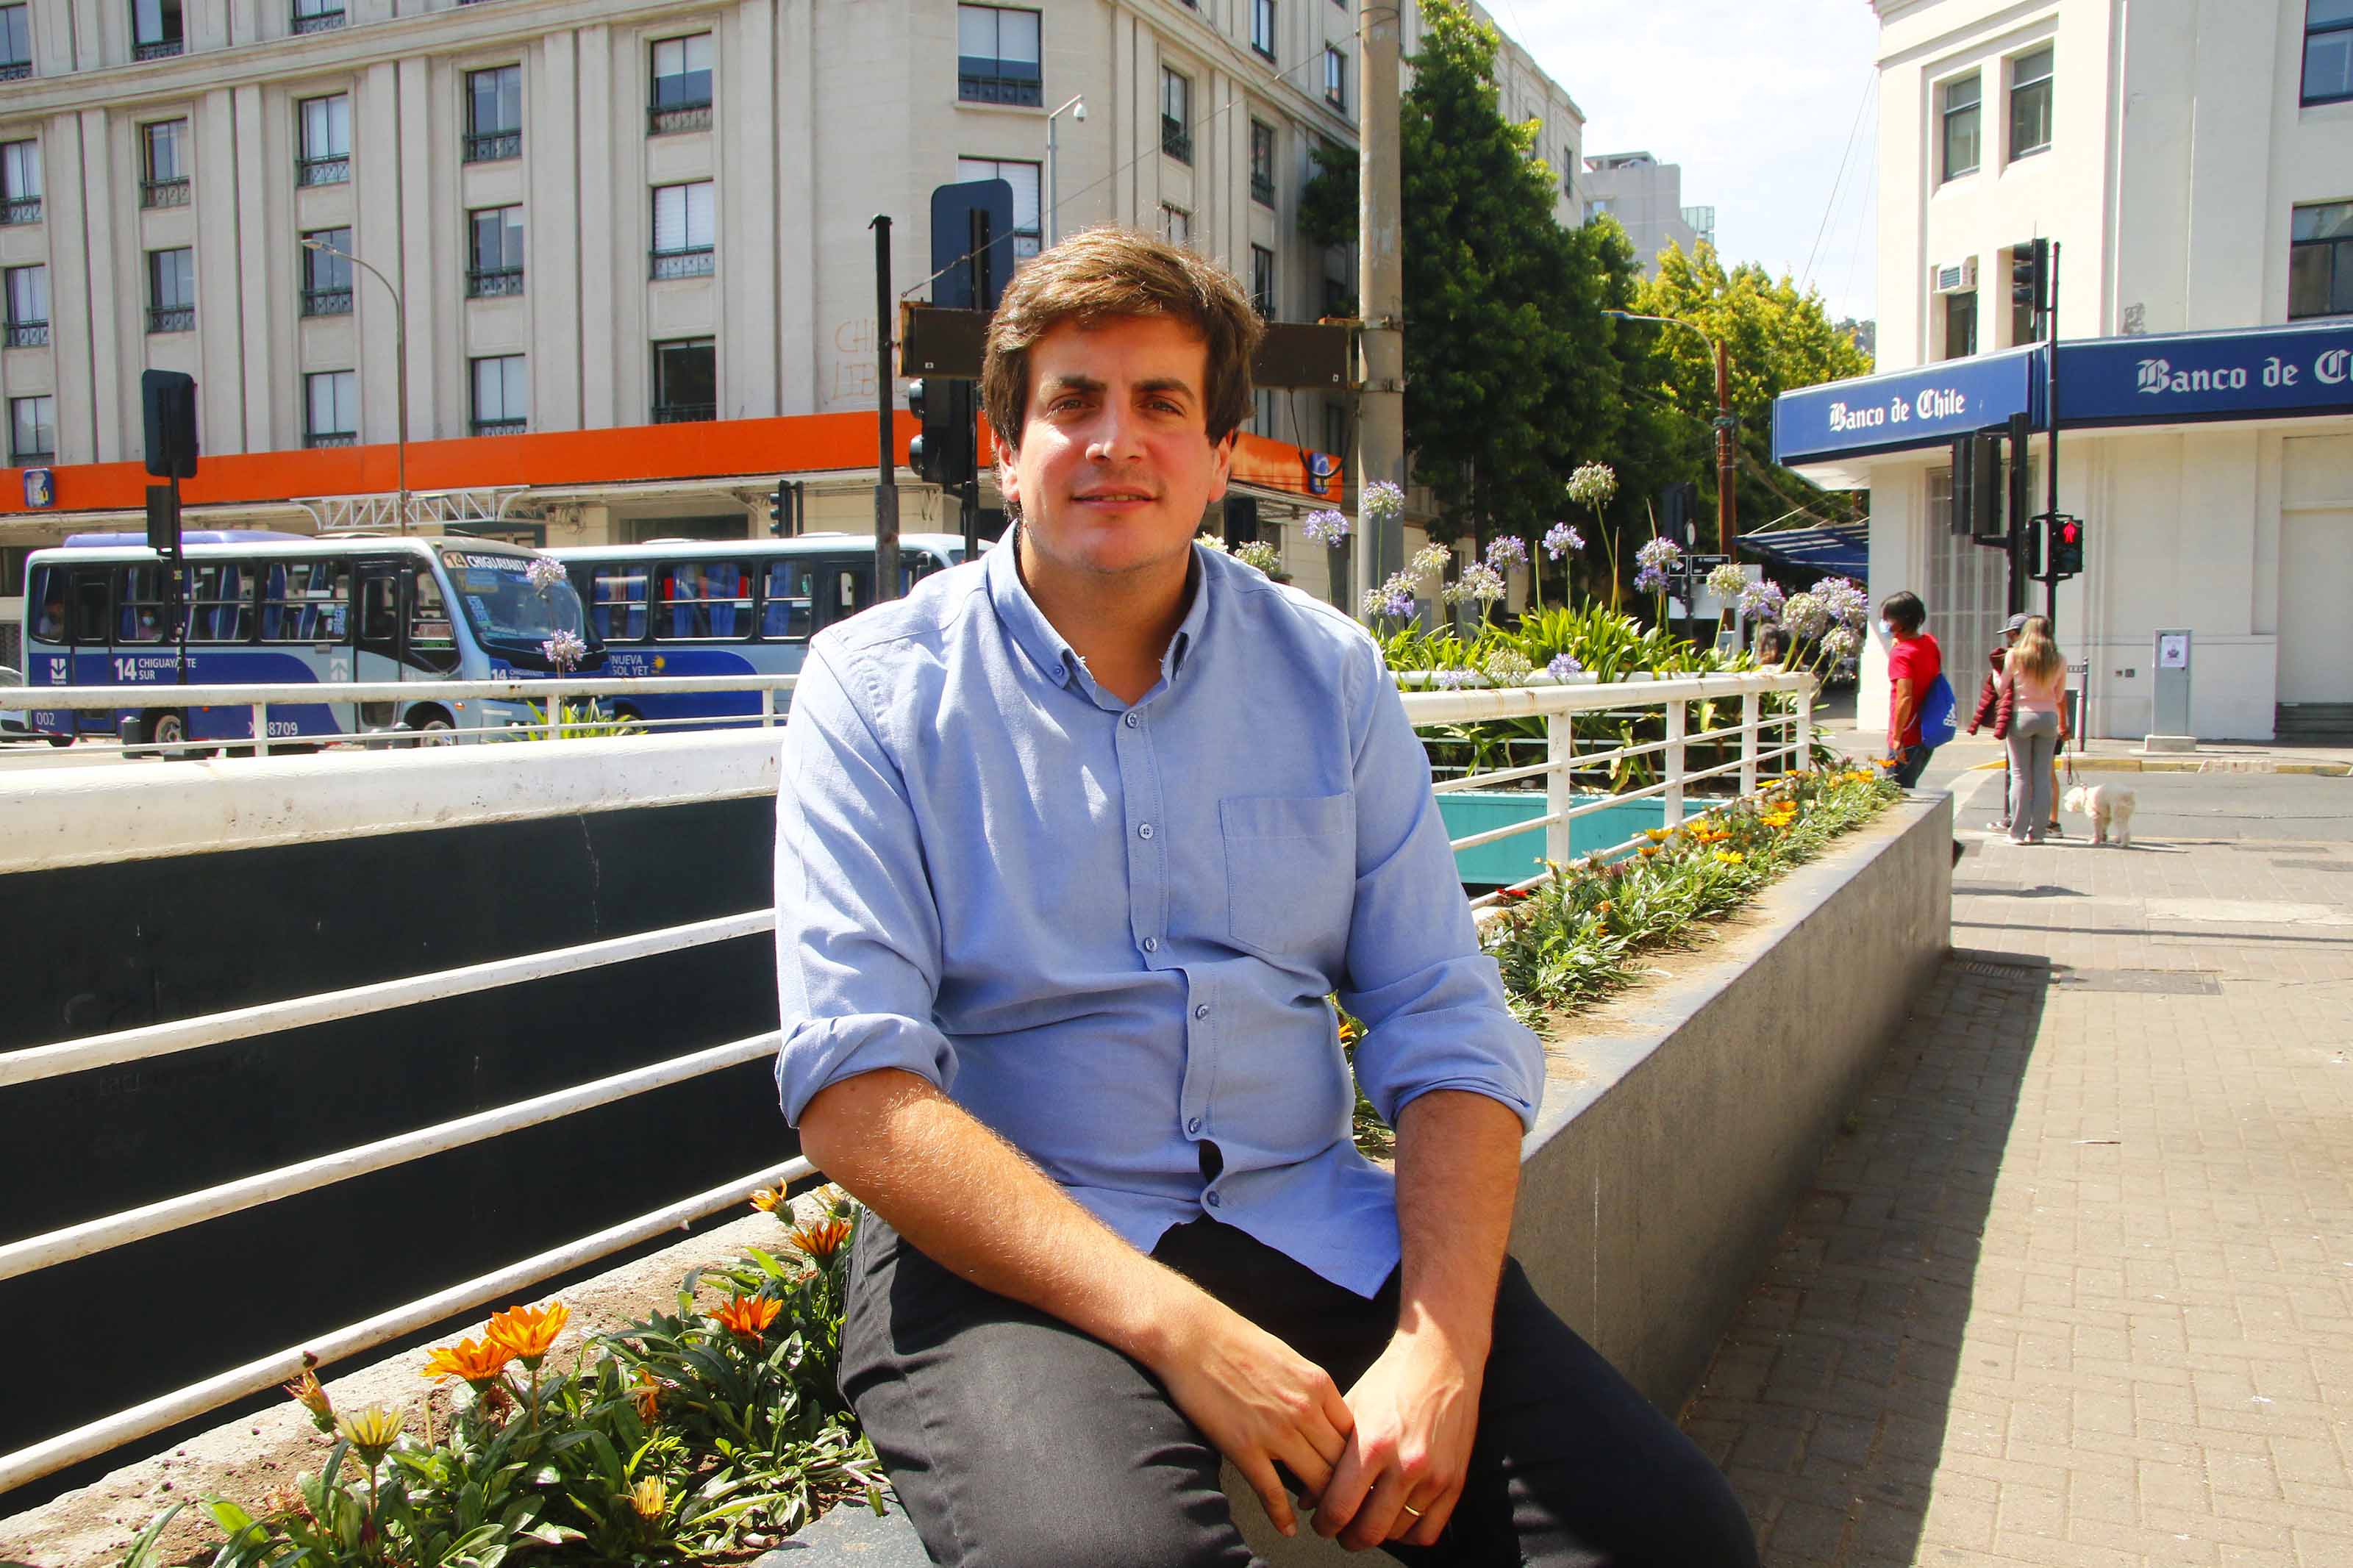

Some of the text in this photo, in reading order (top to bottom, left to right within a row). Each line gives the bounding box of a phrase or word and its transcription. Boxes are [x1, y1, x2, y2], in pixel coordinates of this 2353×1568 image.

[2135, 349, 2353, 394] Banco de C
[1829, 388, 1965, 432] Banco de Chile
[446, 554, 466, 567] 14
[611, 654, 643, 665] NUEVA
[114, 658, 138, 681] 14
[138, 670, 156, 680] SUR
[491, 669, 507, 681] 14
[612, 665, 649, 676] SOL YET
[37, 712, 55, 726] 002
